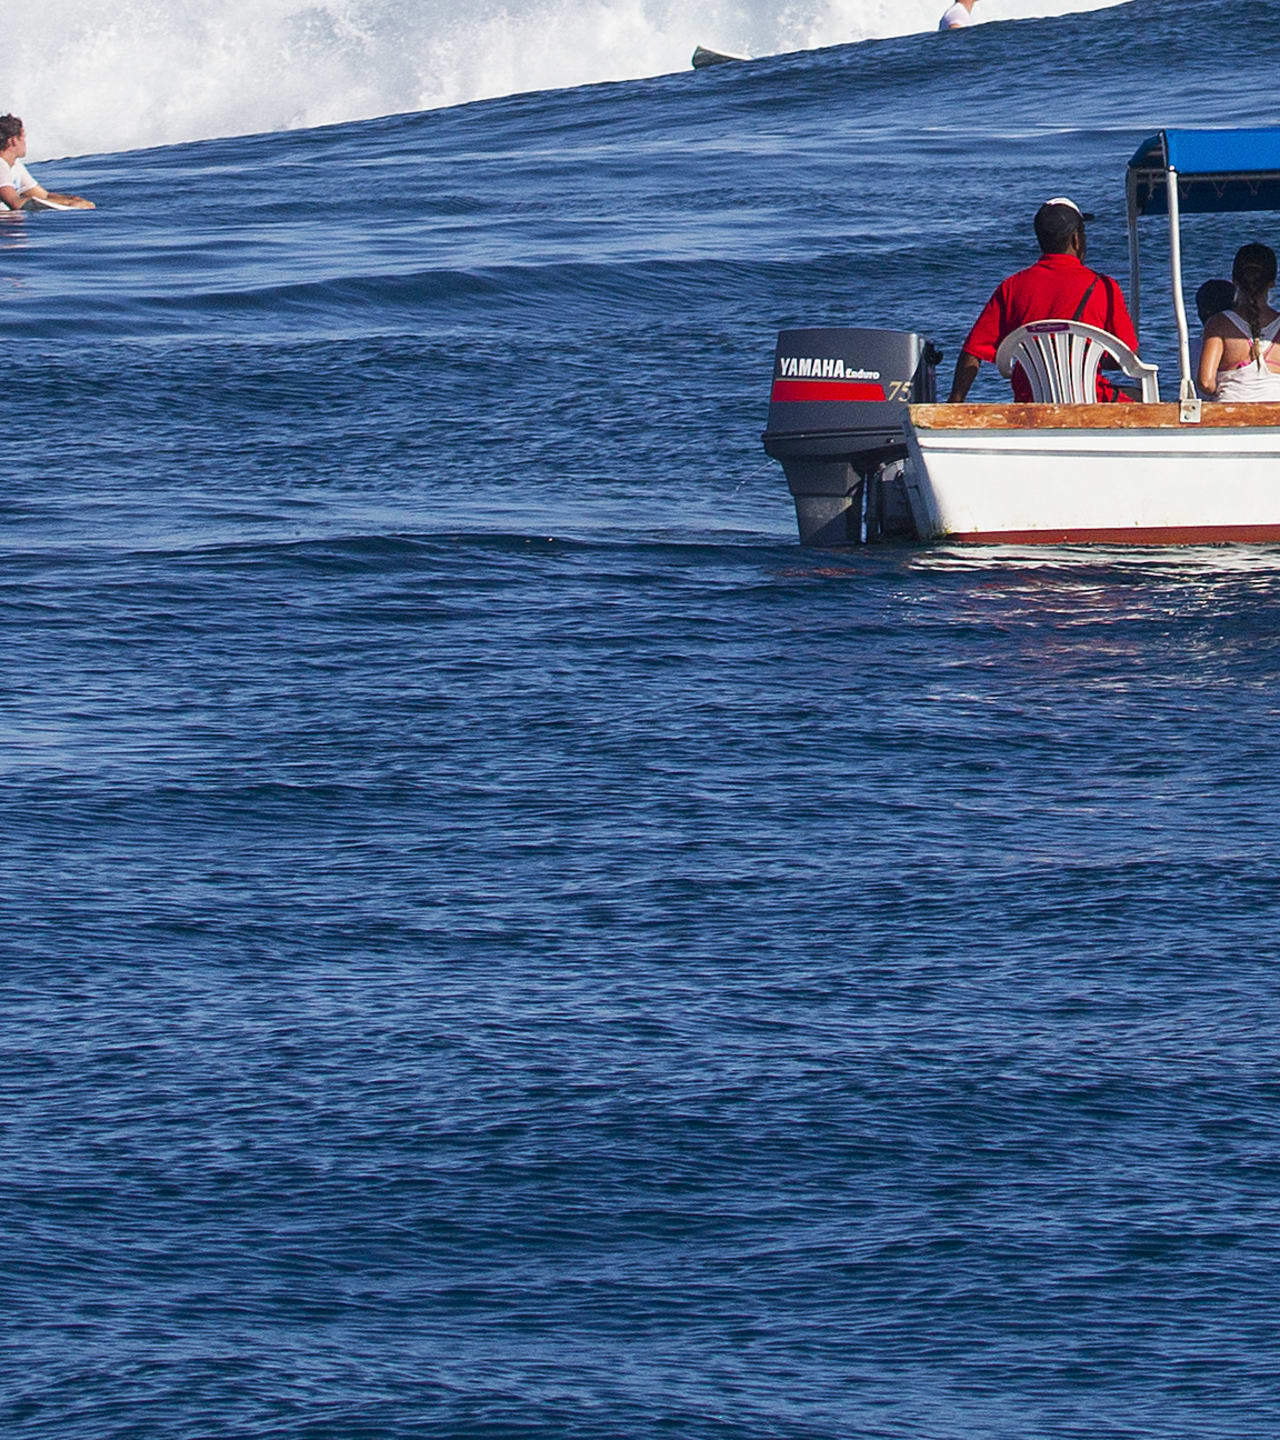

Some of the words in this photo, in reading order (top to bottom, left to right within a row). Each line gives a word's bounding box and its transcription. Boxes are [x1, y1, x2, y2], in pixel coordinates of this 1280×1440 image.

[780, 357, 845, 378] YAMAHA
[845, 368, 881, 380] Enduro
[888, 380, 914, 402] 75
